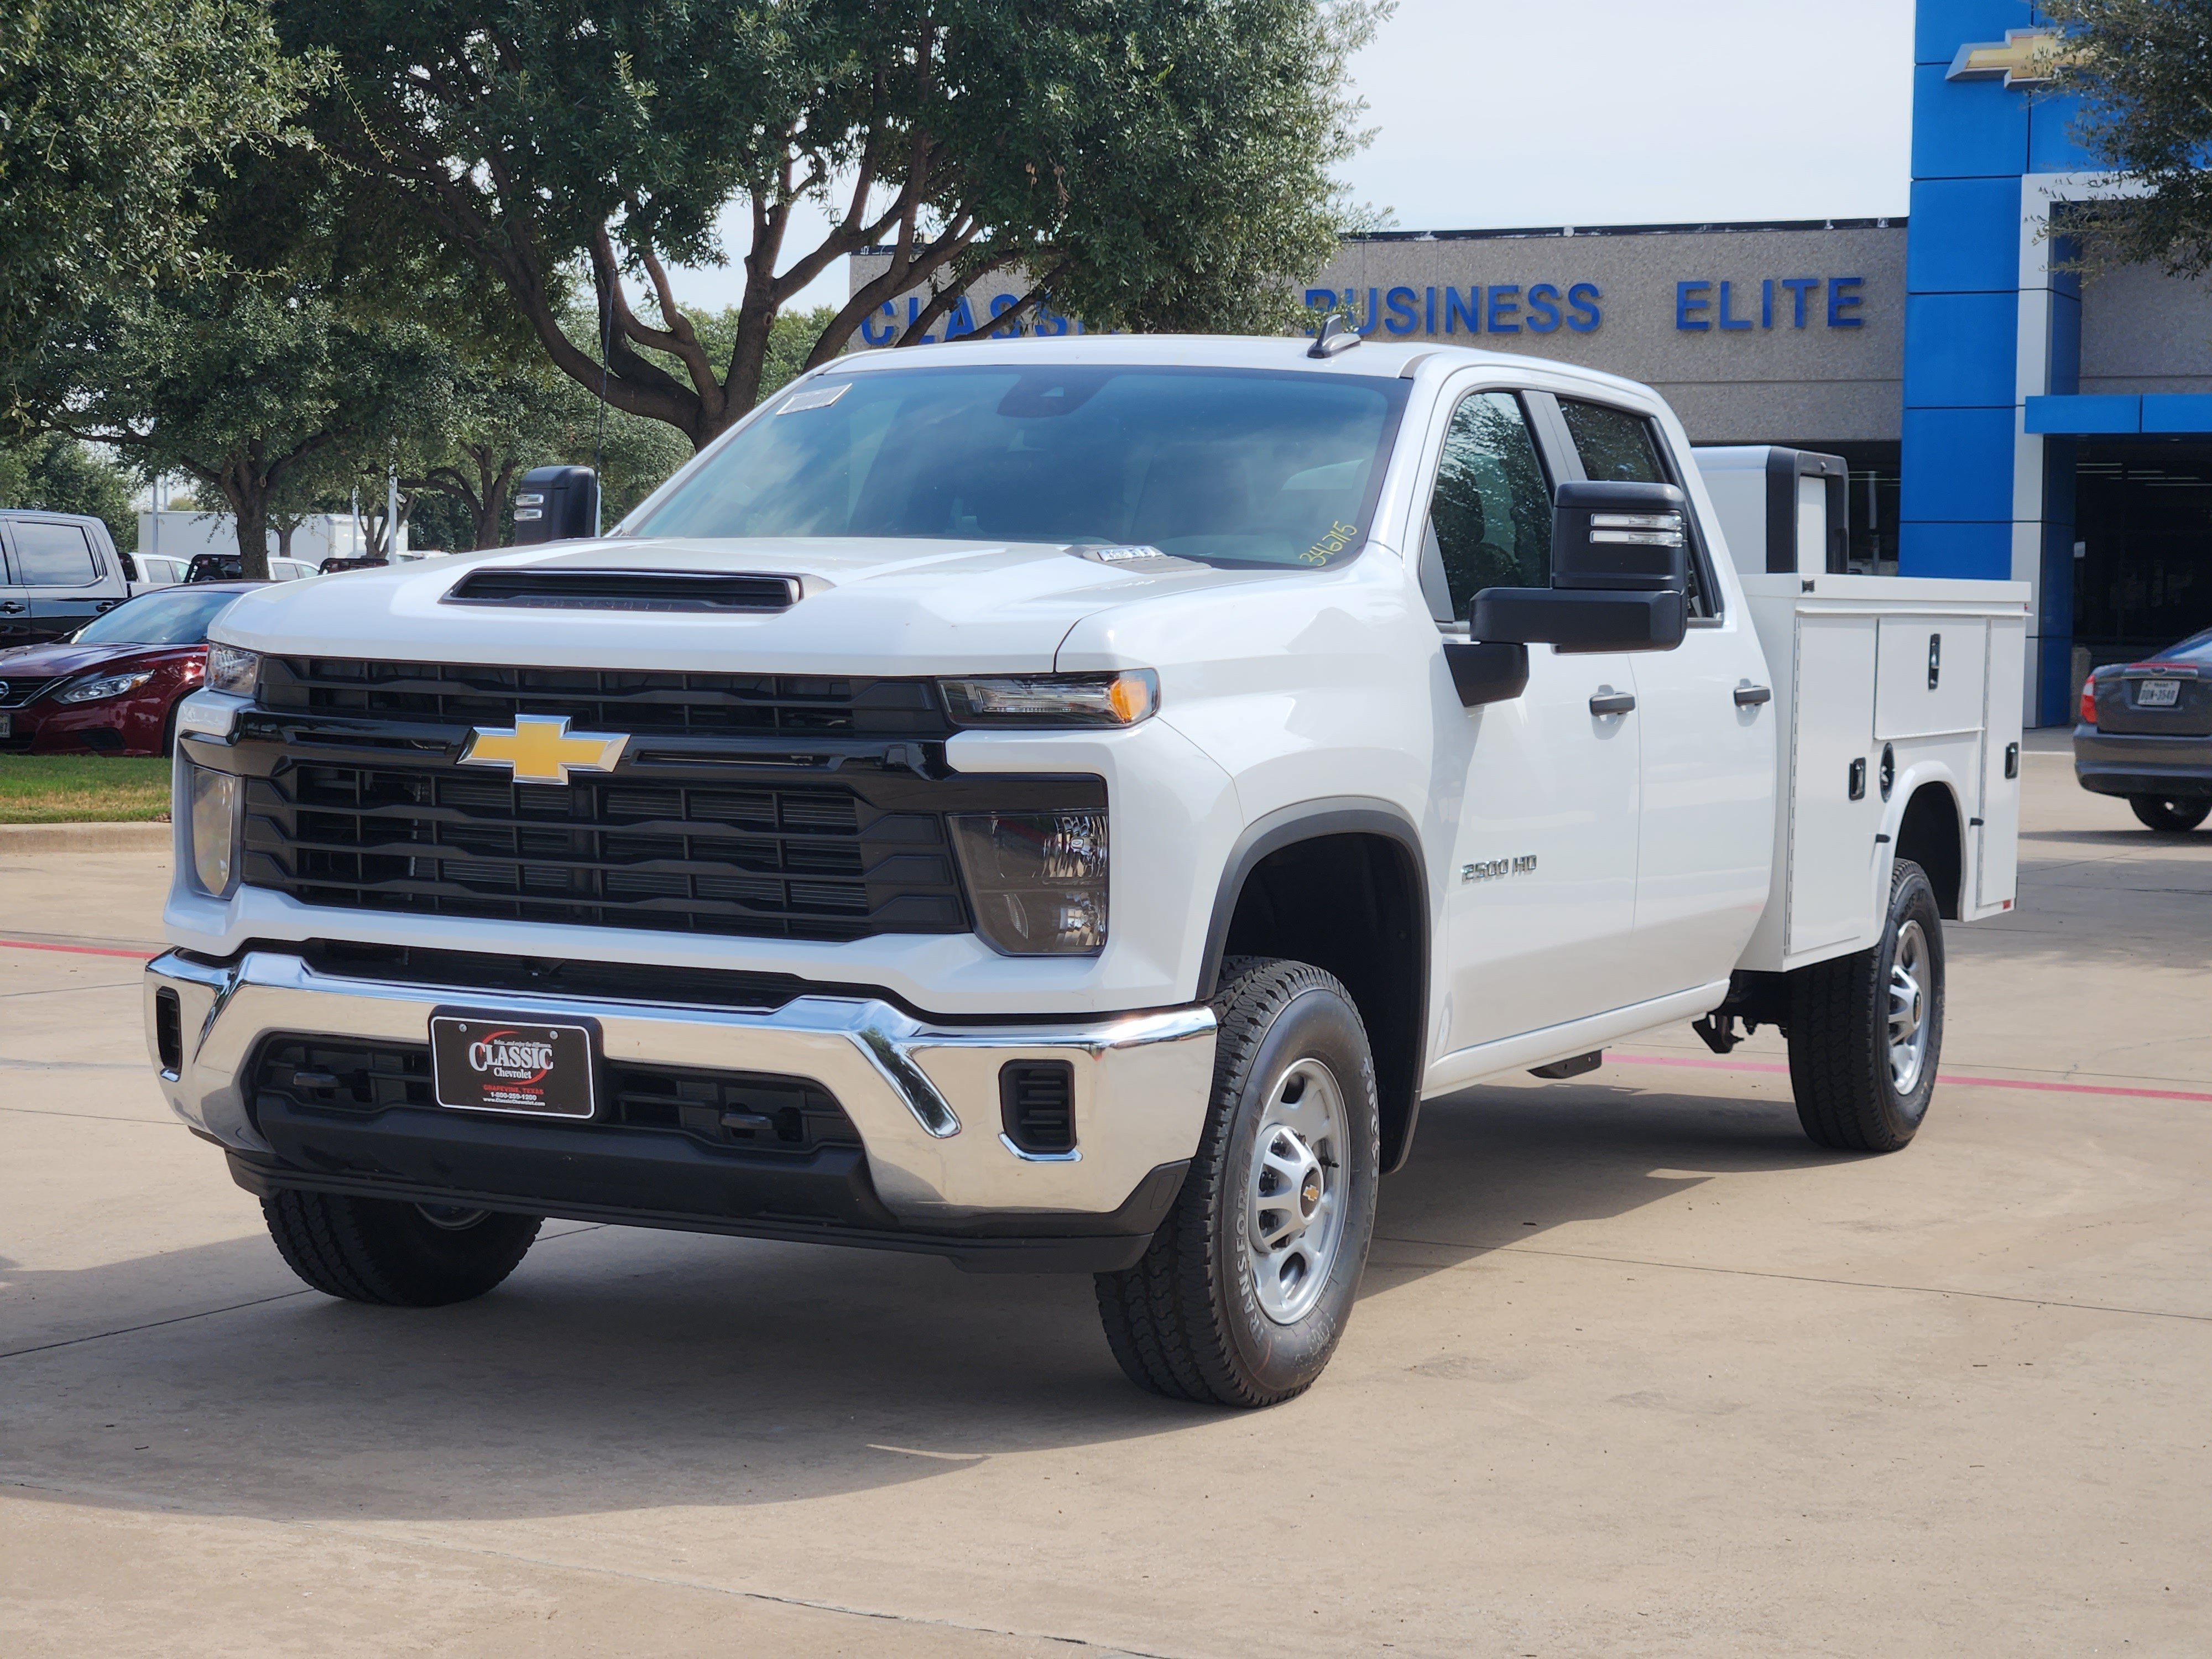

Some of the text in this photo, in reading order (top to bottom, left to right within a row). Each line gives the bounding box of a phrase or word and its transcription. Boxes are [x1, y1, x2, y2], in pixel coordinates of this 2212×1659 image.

[861, 294, 1123, 347] CLASS
[1676, 277, 1863, 330] ELITE
[1460, 855, 1537, 881] 2500 HD
[469, 1042, 554, 1072] CLASSIC
[493, 1067, 532, 1079] Chevrolet
